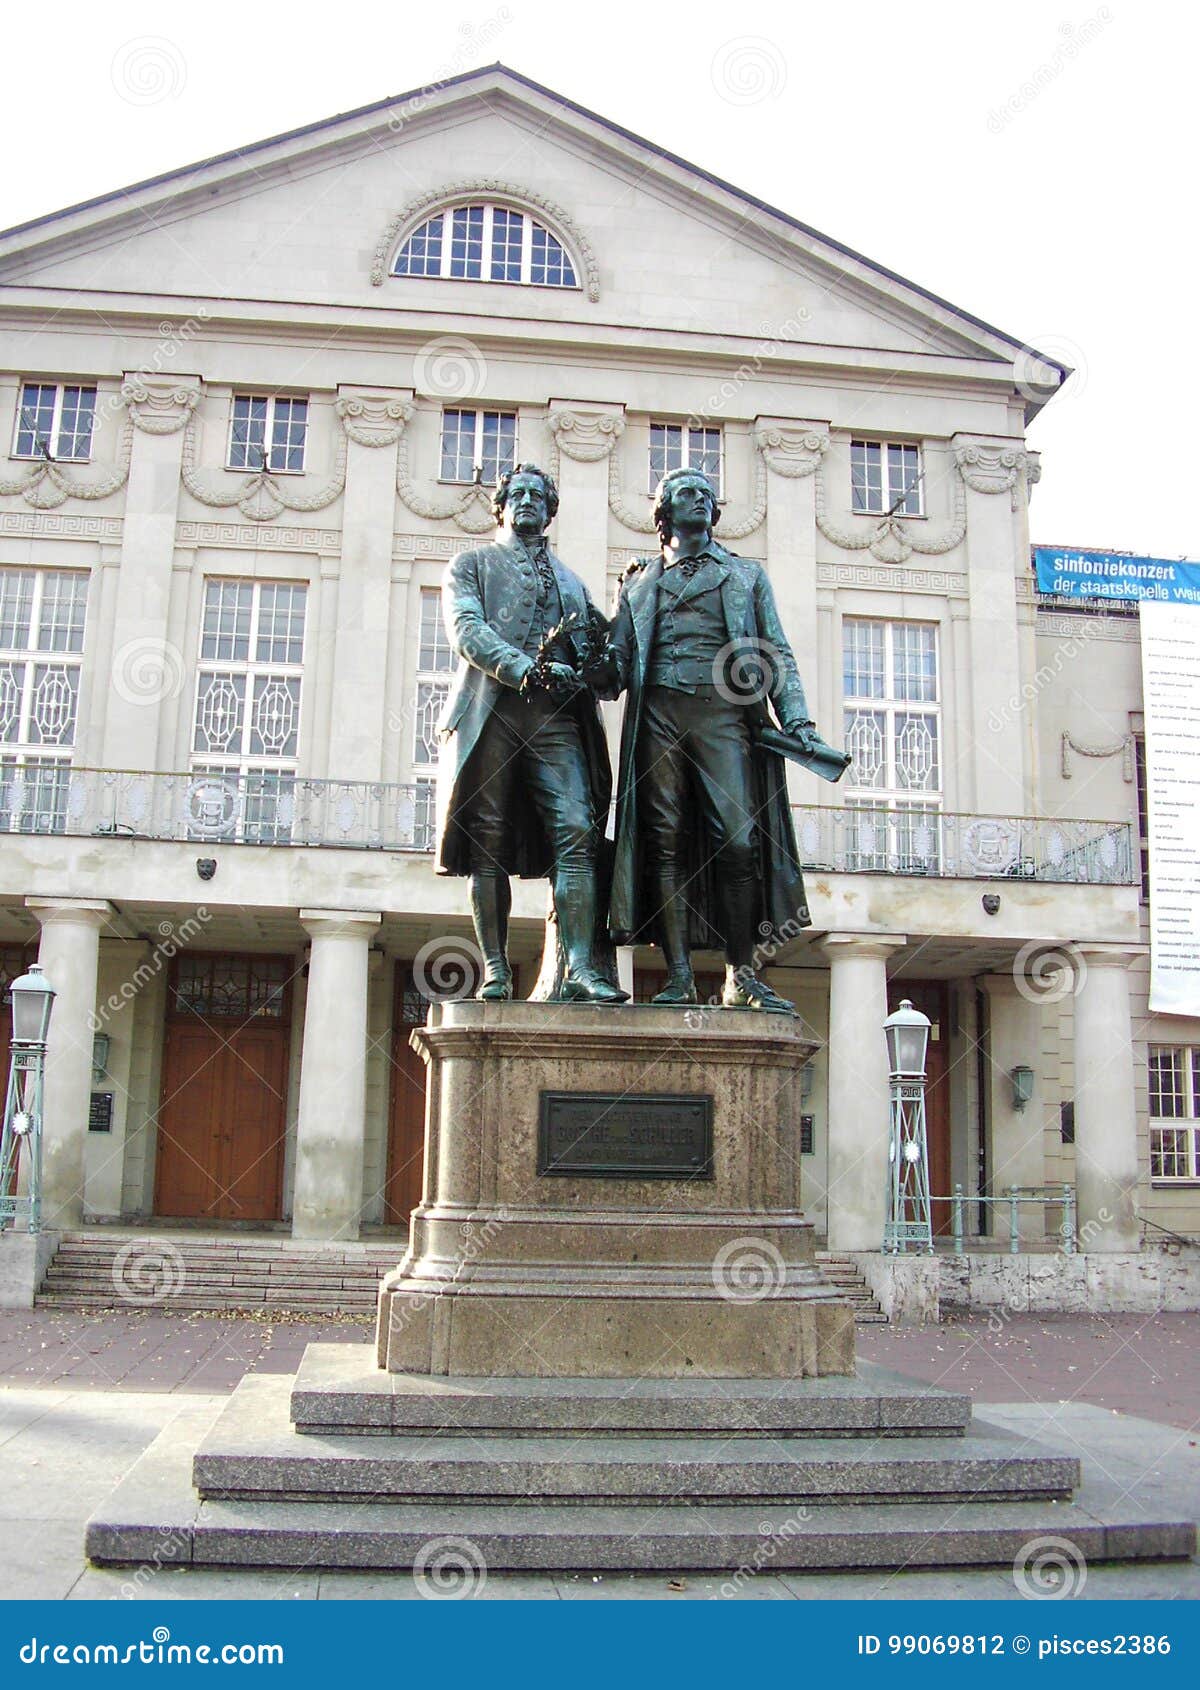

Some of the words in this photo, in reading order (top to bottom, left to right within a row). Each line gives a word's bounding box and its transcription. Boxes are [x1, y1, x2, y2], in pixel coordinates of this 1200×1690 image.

[1054, 554, 1176, 581] sinfoniekonzert
[1053, 576, 1076, 593] der
[1080, 580, 1169, 600] staatskapelle
